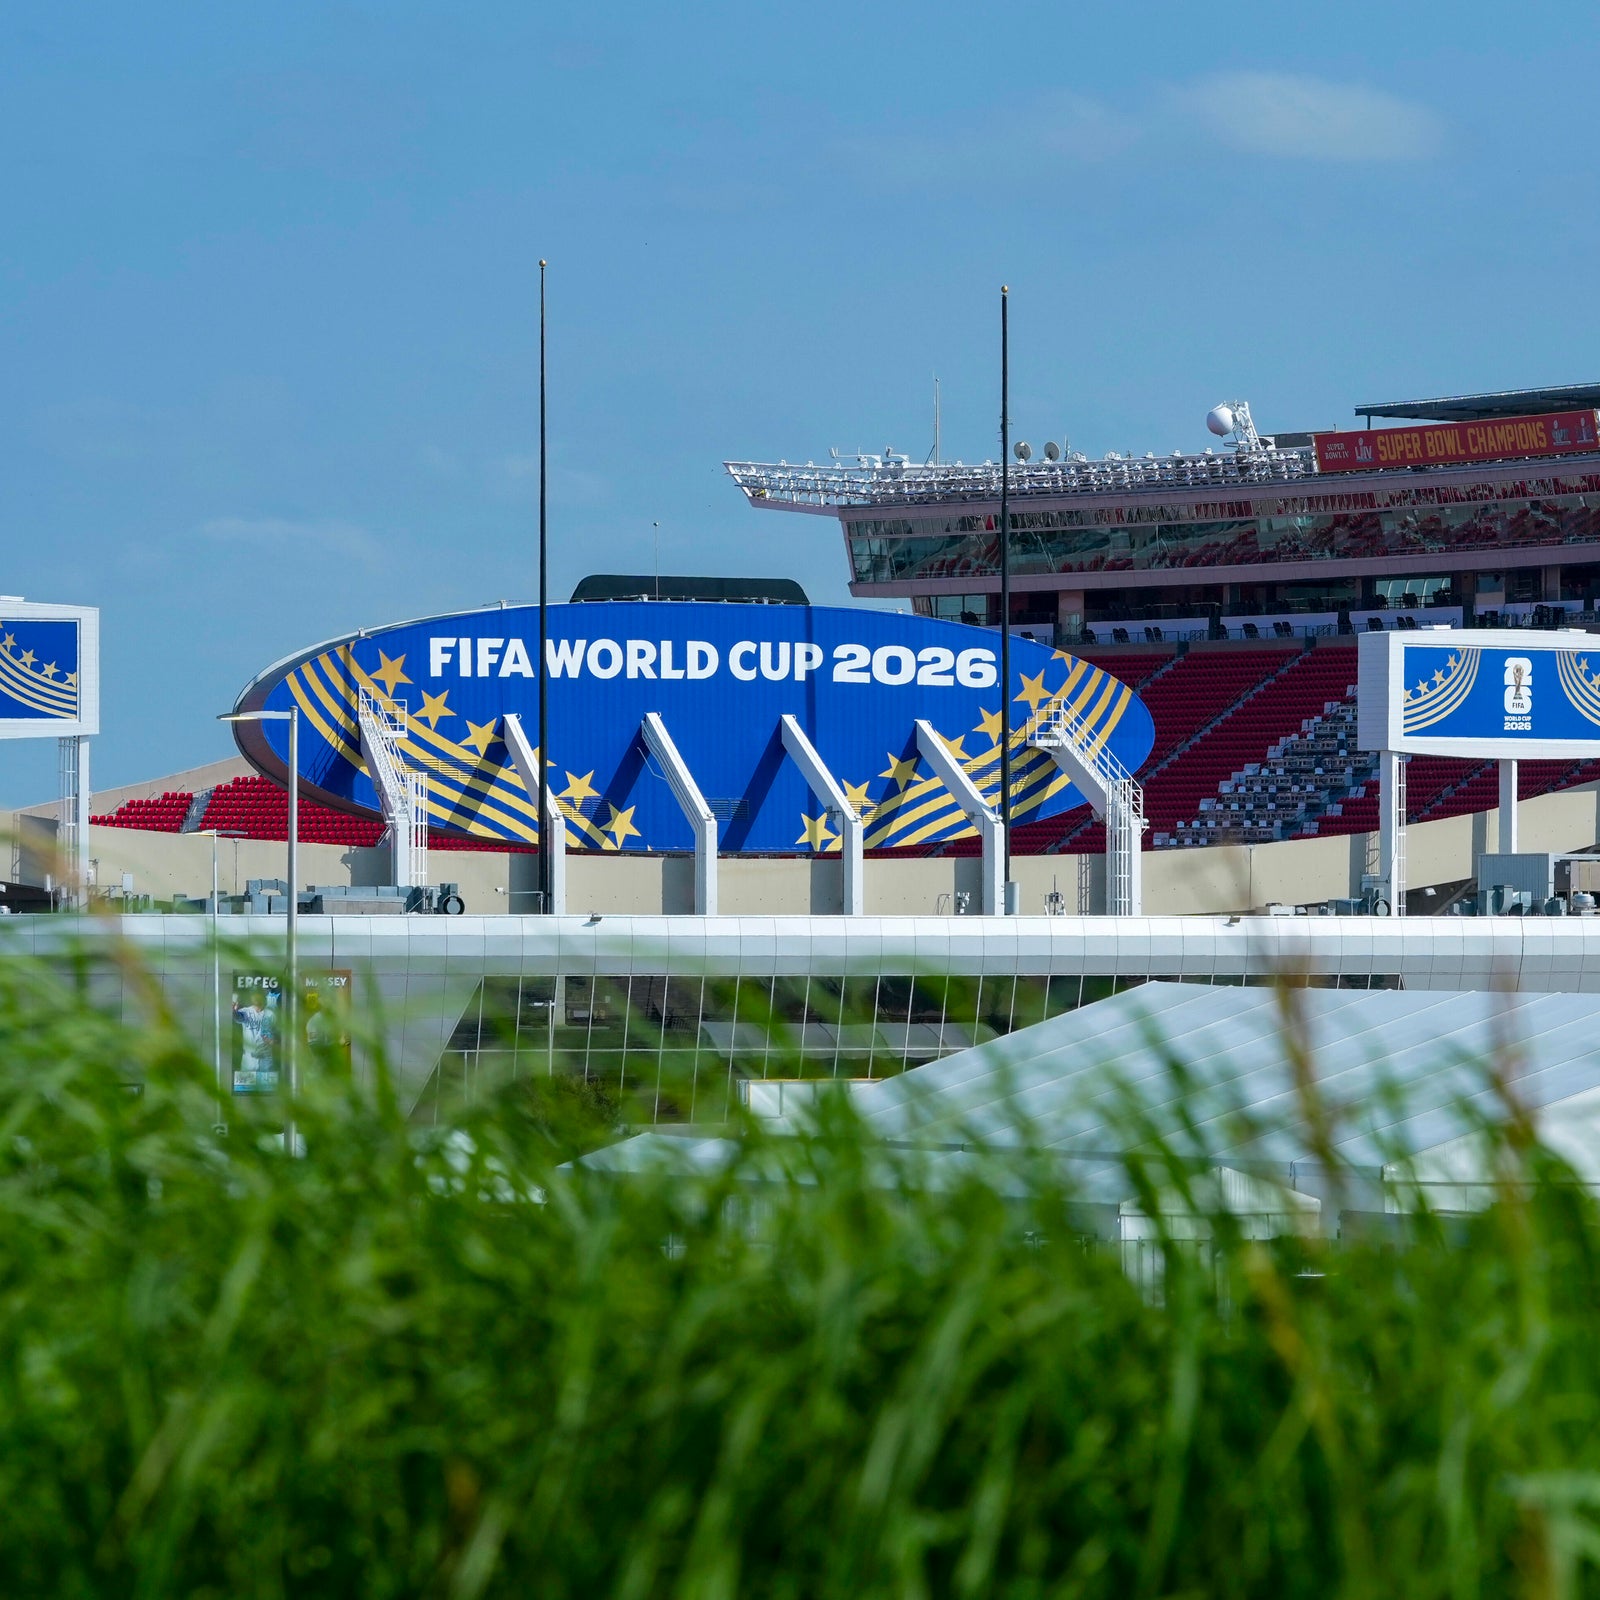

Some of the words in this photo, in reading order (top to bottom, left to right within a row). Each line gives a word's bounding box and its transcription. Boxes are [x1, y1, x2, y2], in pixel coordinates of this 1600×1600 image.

[1376, 432, 1423, 461] SUPER
[1424, 429, 1466, 457] BOWL
[1467, 422, 1547, 453] CHAMPIONS
[1326, 442, 1345, 451] SUPER
[1324, 451, 1342, 460] BOWL
[429, 637, 535, 678] FIFA
[545, 638, 720, 680] WORLD
[728, 640, 824, 681] CUP
[832, 643, 997, 688] 2026
[1504, 722, 1532, 731] 2026
